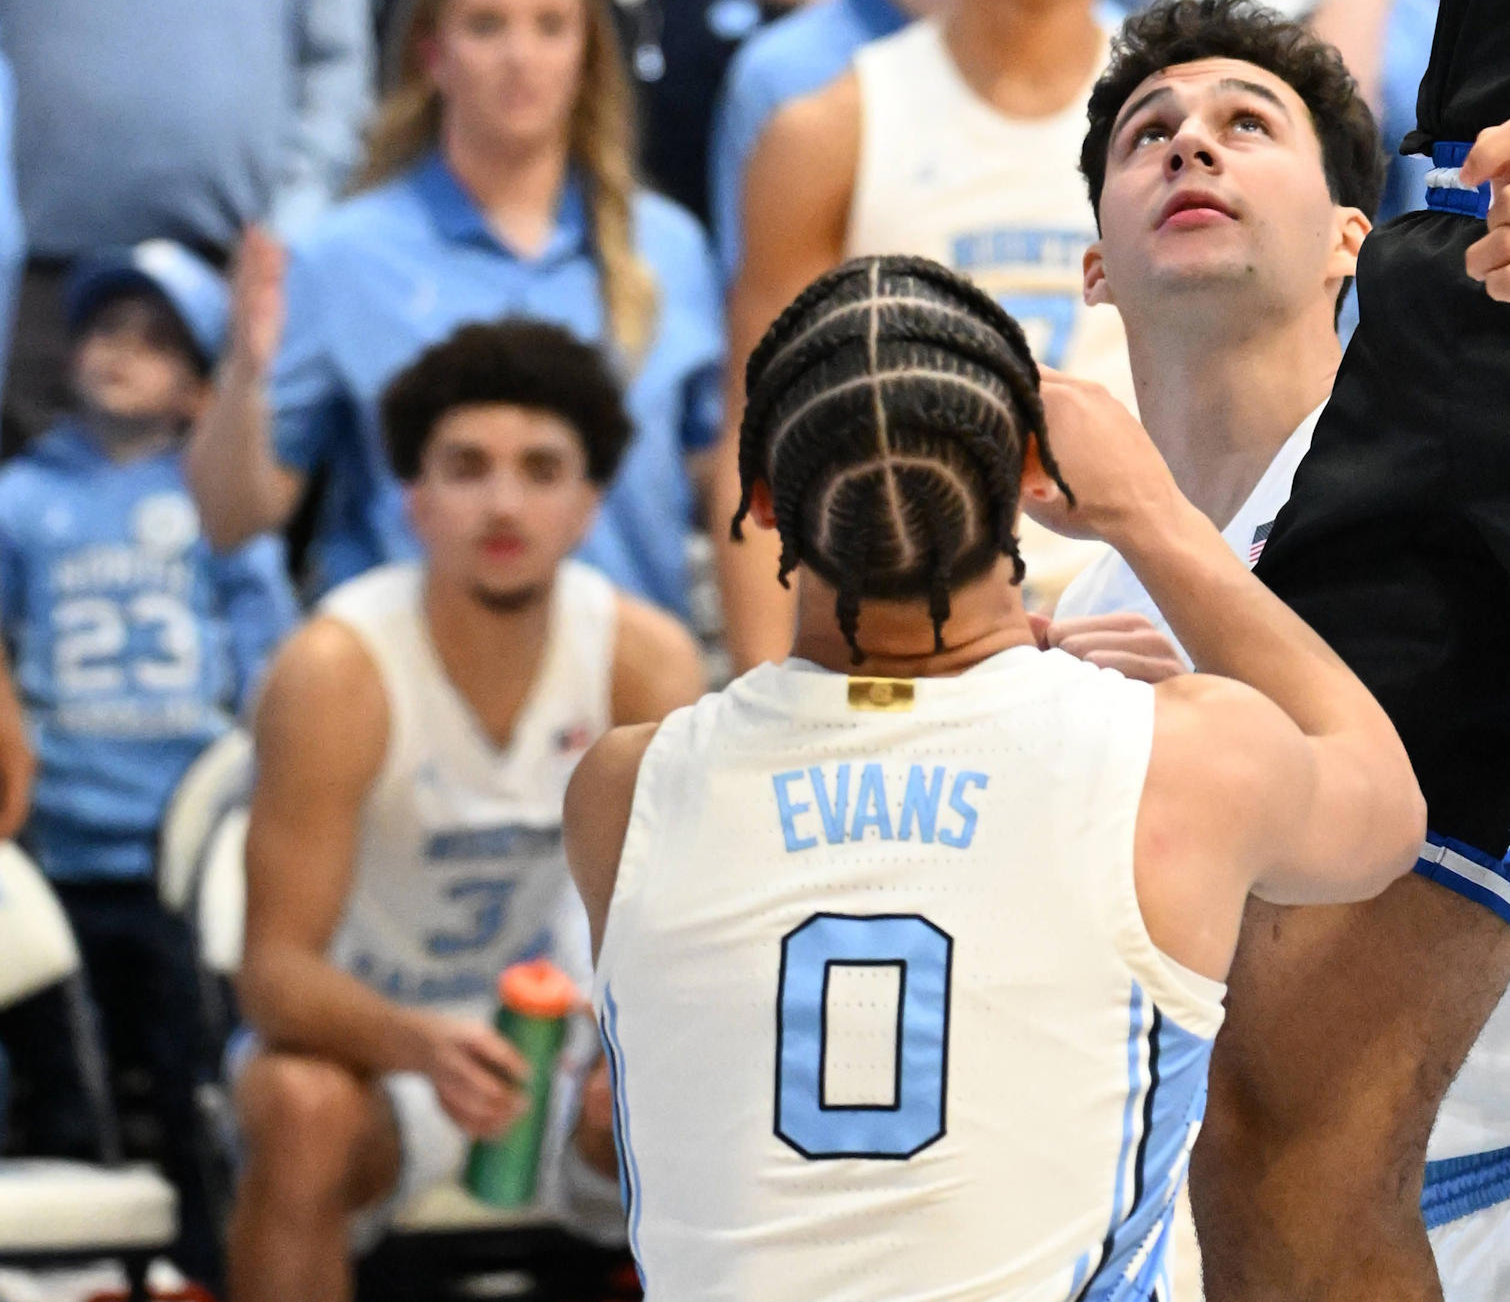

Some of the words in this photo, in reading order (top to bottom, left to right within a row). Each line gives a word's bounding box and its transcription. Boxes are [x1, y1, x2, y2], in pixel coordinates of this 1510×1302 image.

[53, 594, 200, 692] 23
[772, 763, 989, 853] EVANS
[773, 911, 954, 1161] 0
